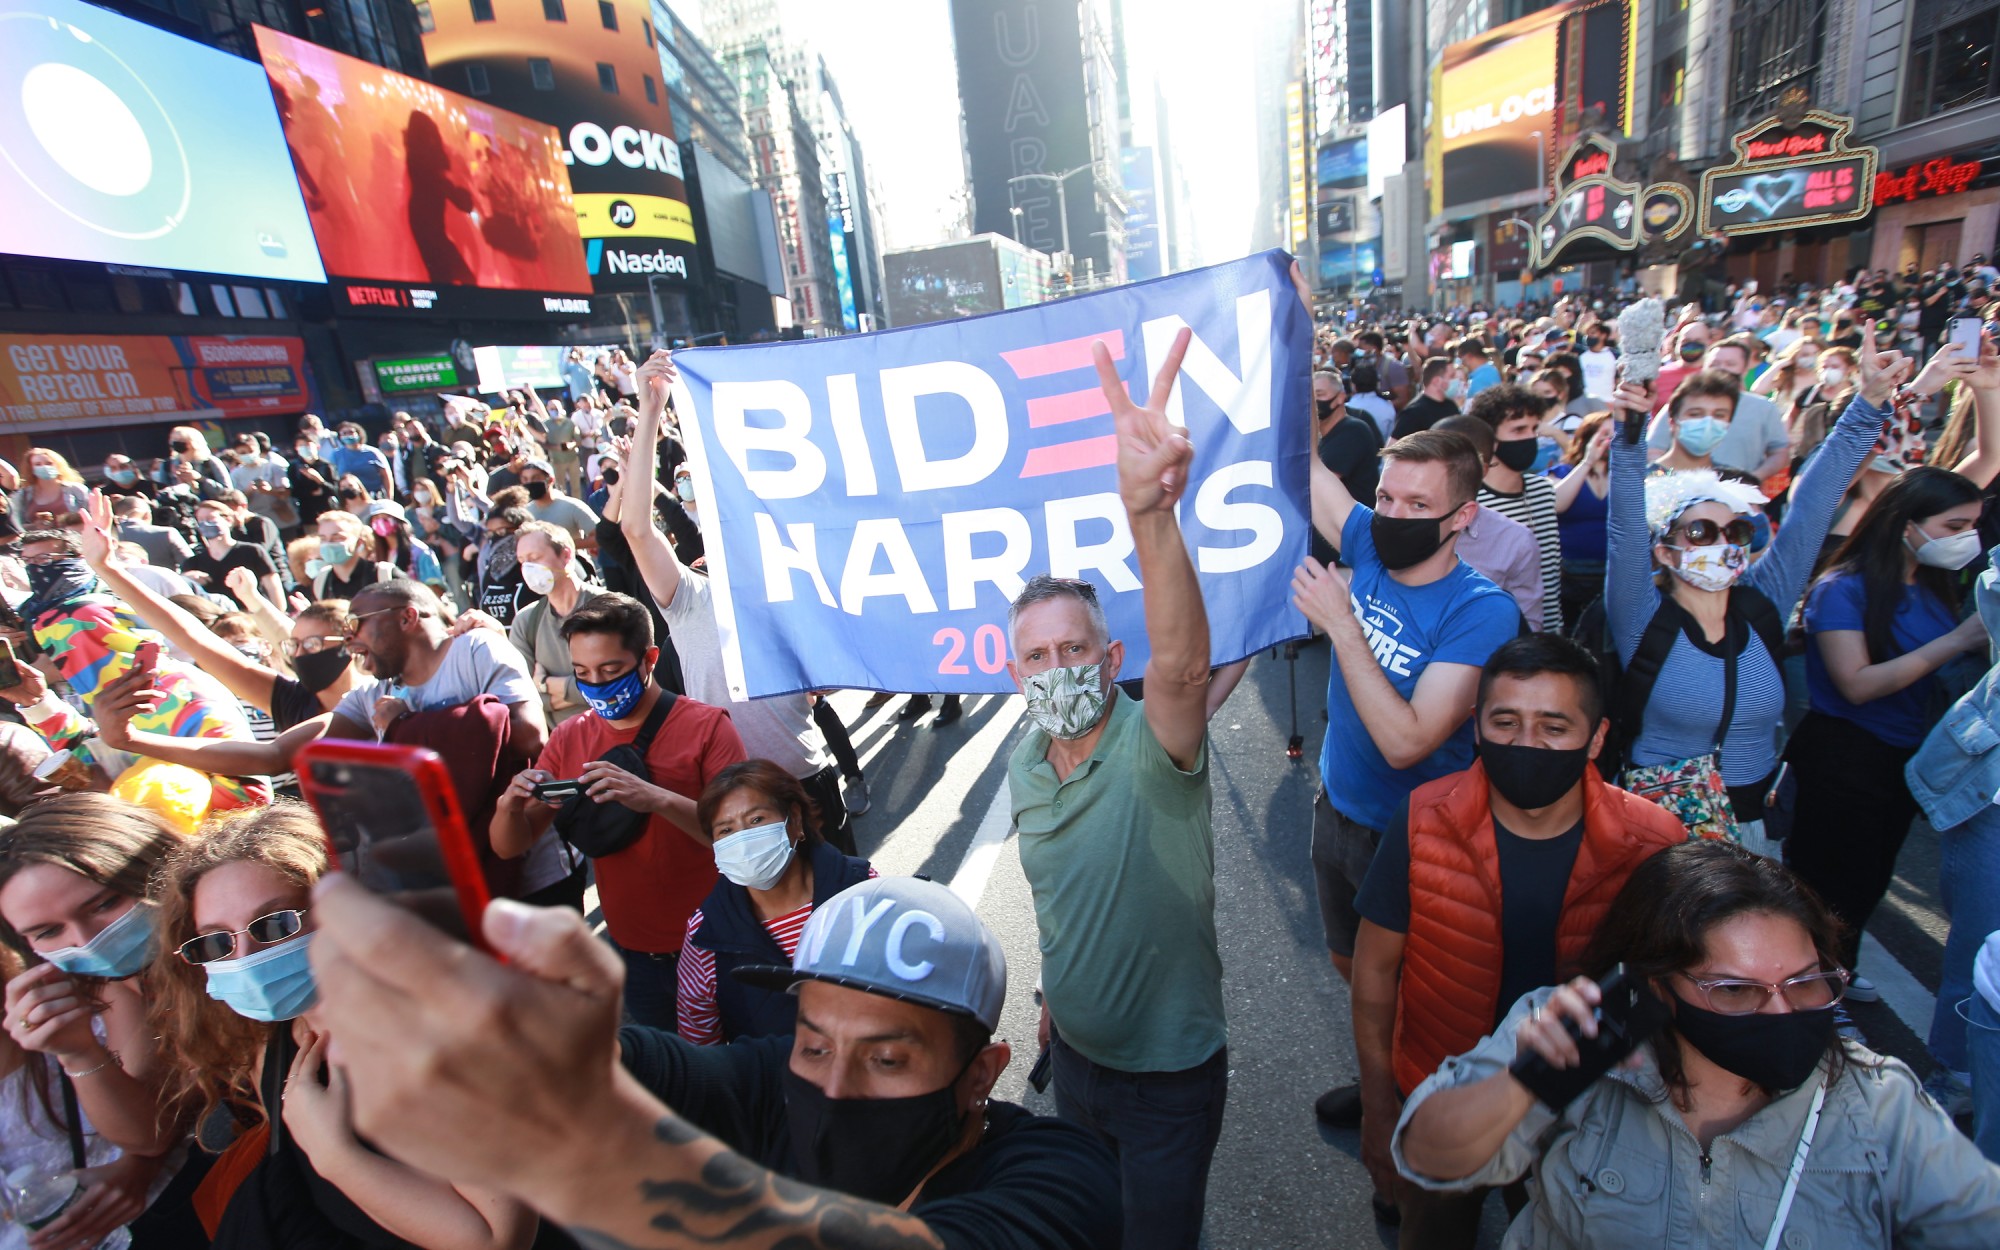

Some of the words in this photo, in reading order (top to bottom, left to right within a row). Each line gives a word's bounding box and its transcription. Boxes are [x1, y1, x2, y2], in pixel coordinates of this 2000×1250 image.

[1873, 164, 1920, 206] Rock
[1918, 156, 1983, 195] Shop
[612, 205, 635, 224] JD
[606, 249, 687, 280] Nasdaq
[346, 285, 400, 308] NETFLIX
[378, 361, 453, 377] STARBUCKS
[393, 373, 442, 386] COFFEE
[711, 288, 1274, 500] BIDEN
[753, 460, 1285, 616] HARRS
[483, 593, 512, 605] RISE
[488, 605, 507, 618] UP
[792, 896, 945, 982] NYC
